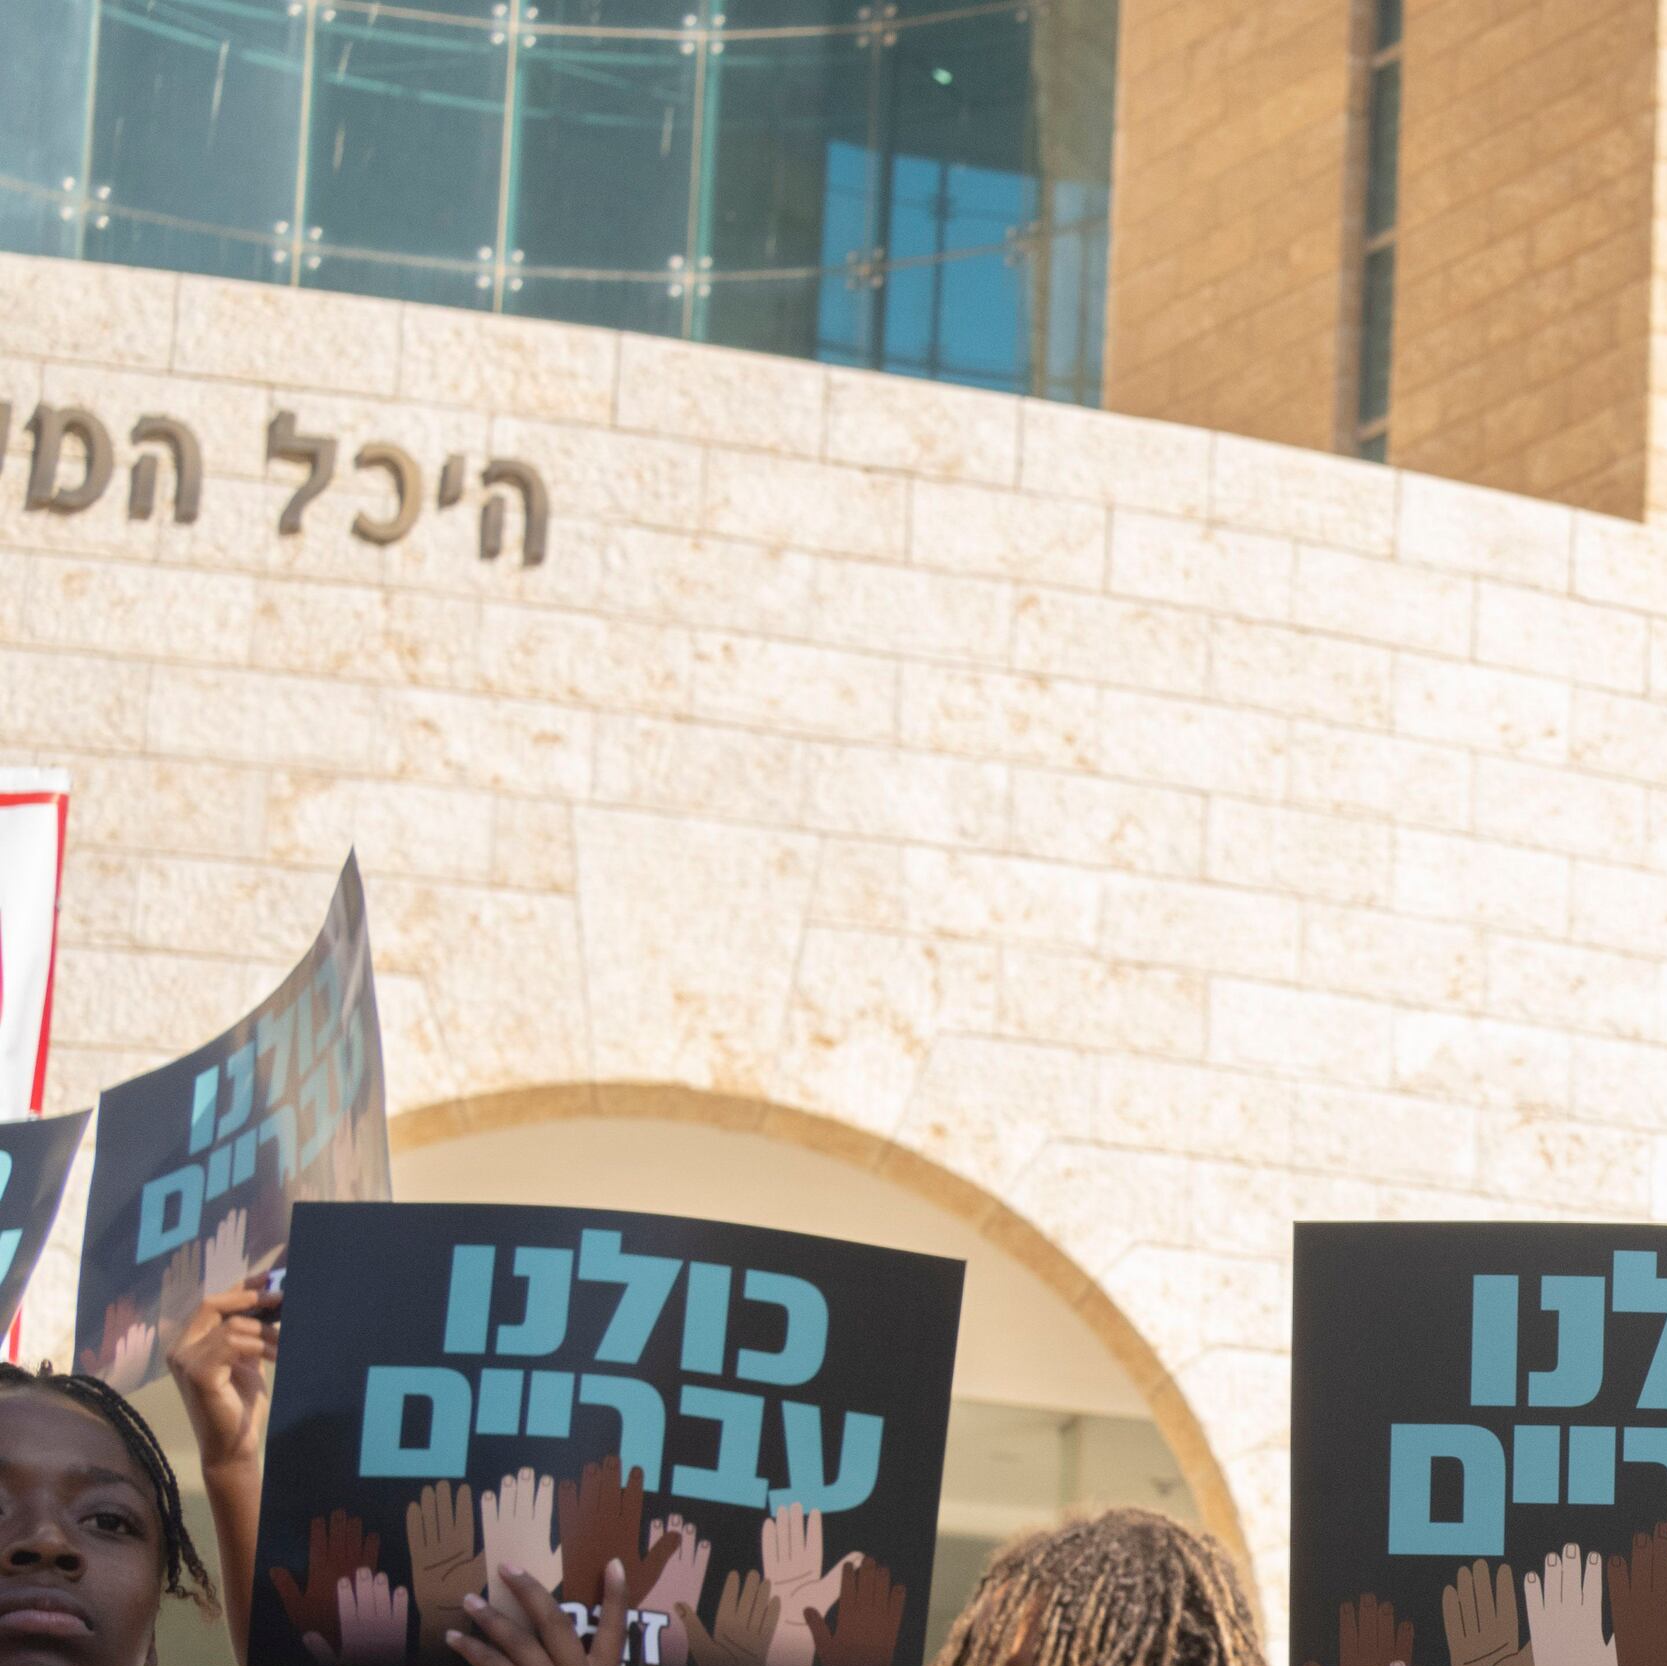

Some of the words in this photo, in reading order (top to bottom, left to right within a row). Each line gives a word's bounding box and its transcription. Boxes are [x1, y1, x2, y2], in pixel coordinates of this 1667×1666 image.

[0, 402, 203, 524] המ
[266, 409, 549, 568] היכל
[190, 954, 341, 1156] כולנו
[443, 1228, 830, 1387] כולנו
[359, 1365, 885, 1515] עבריים
